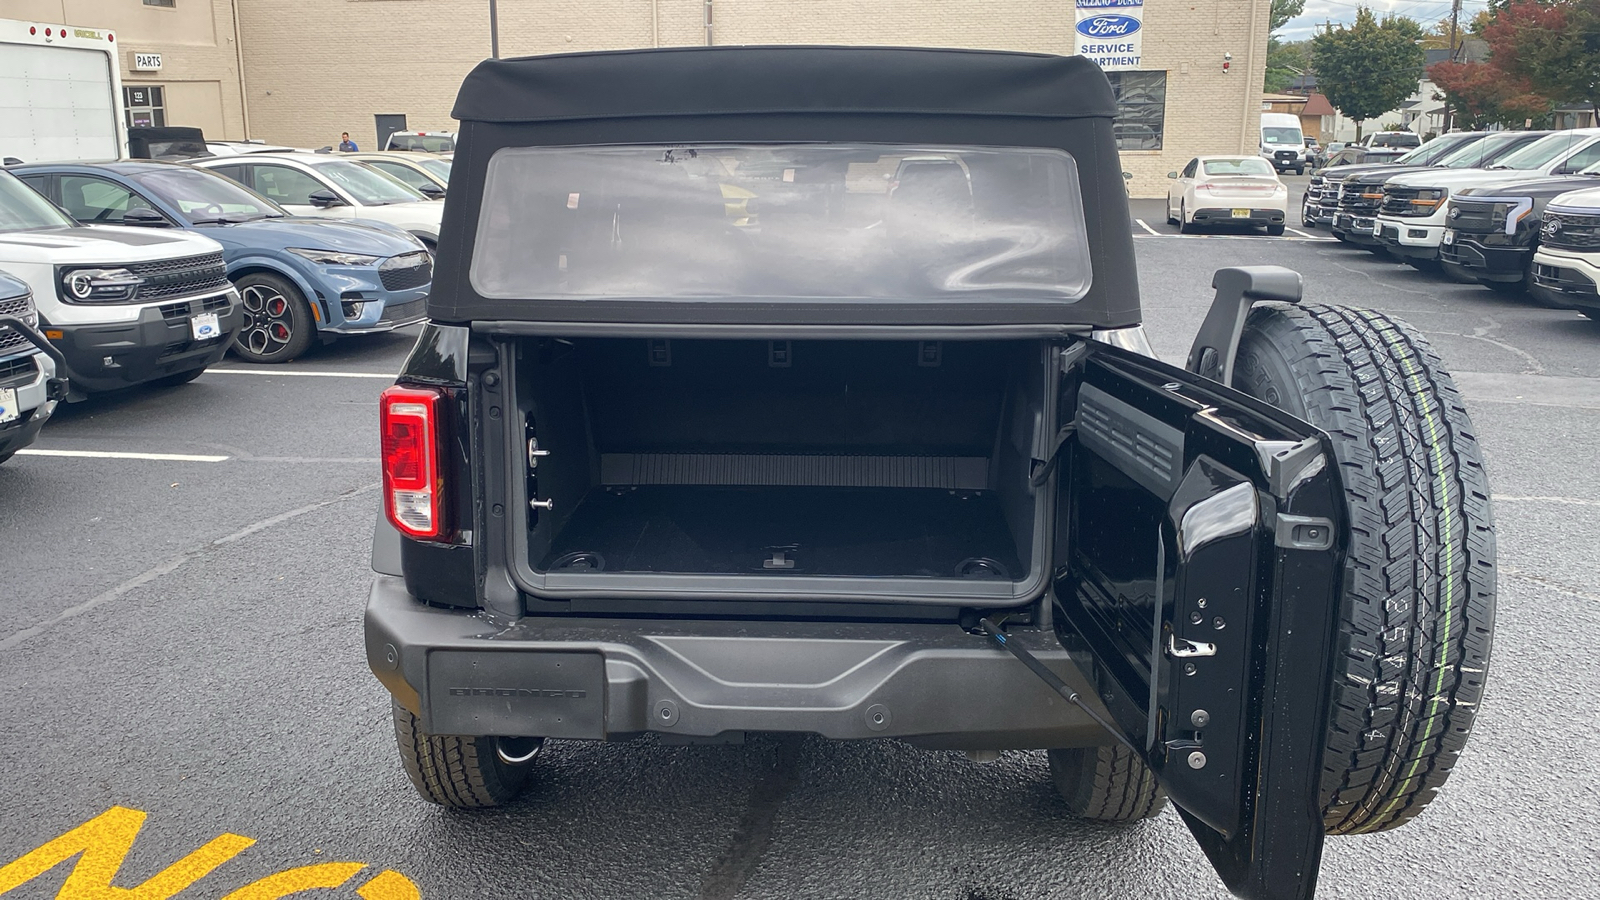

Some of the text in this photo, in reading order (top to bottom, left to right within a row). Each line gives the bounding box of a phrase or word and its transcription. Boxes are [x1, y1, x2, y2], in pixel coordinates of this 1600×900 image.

[1088, 17, 1129, 34] Ford
[1081, 43, 1134, 54] SERVICE
[137, 55, 161, 67] PARTS
[1088, 56, 1141, 66] ARTMENT
[449, 686, 587, 699] BRONCO
